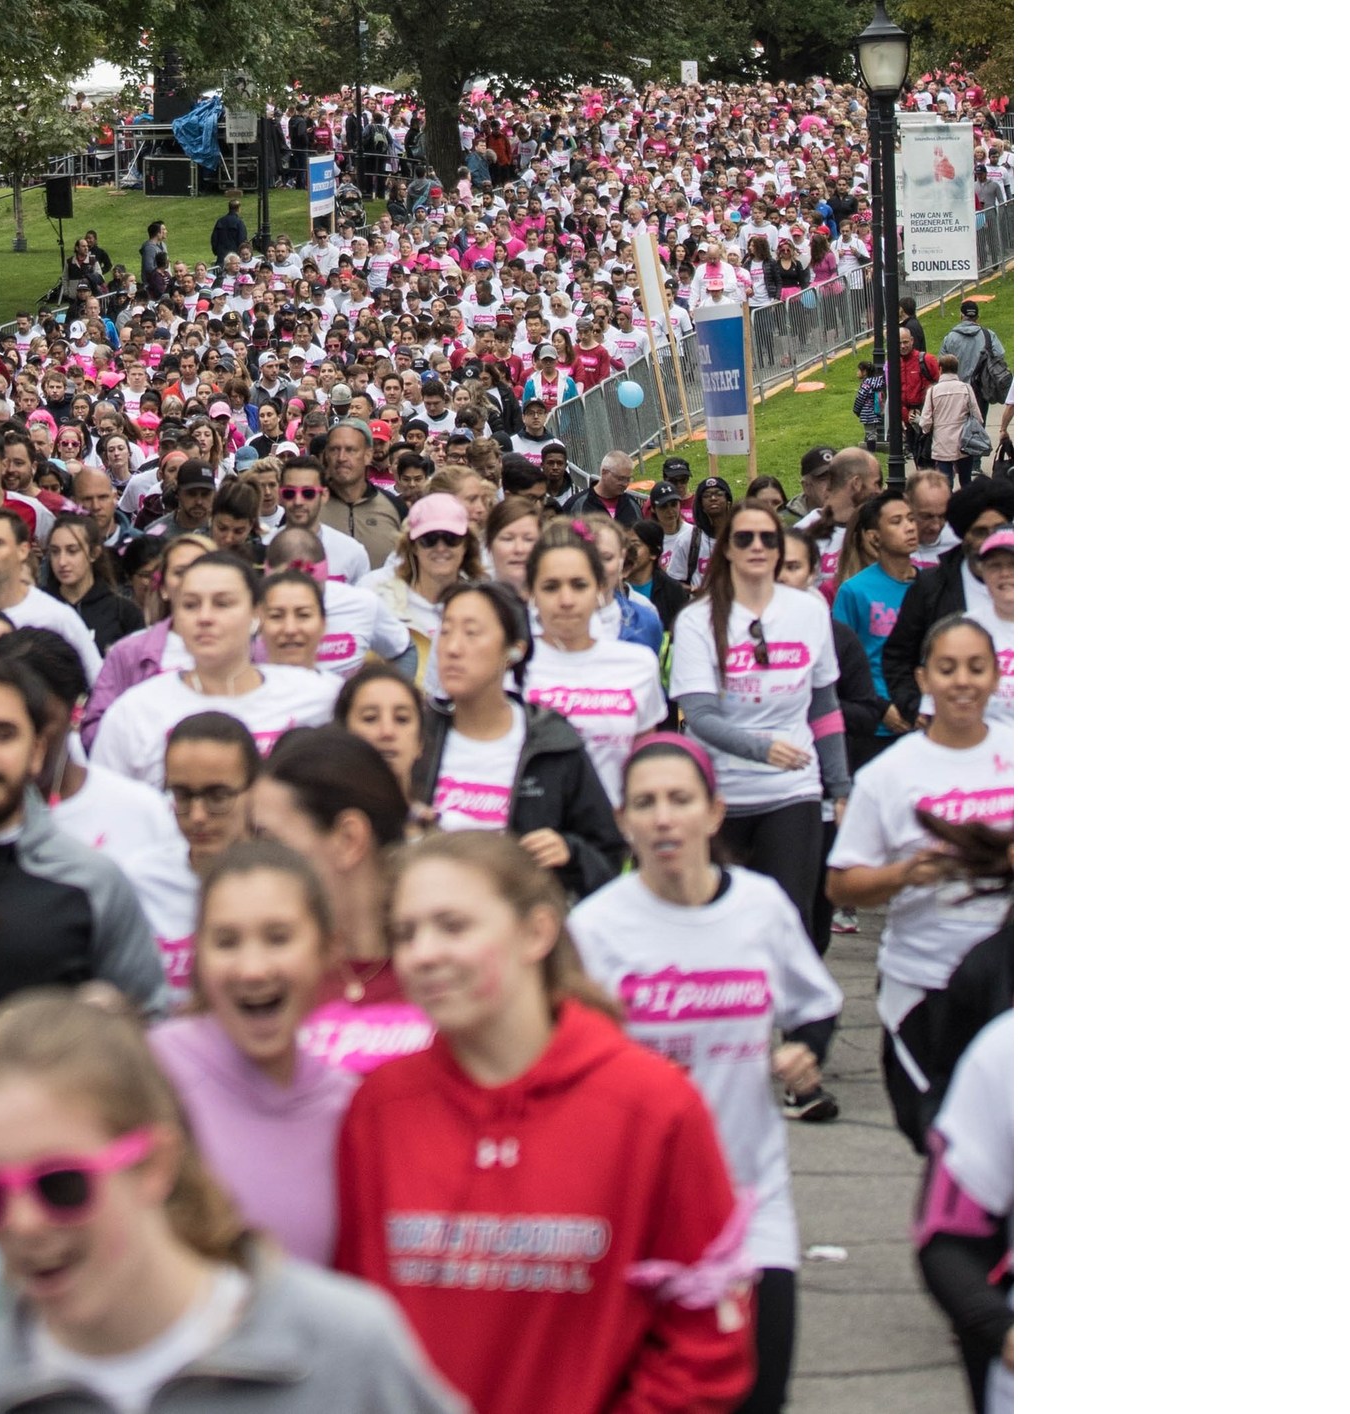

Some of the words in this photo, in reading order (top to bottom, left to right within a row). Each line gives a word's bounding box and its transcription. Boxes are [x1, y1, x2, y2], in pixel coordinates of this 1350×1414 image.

[910, 218, 953, 226] REGENERATE
[910, 226, 943, 234] DAMAGED
[944, 225, 969, 233] HEART?
[911, 259, 971, 271] BOUNDLESS
[711, 369, 740, 392] START
